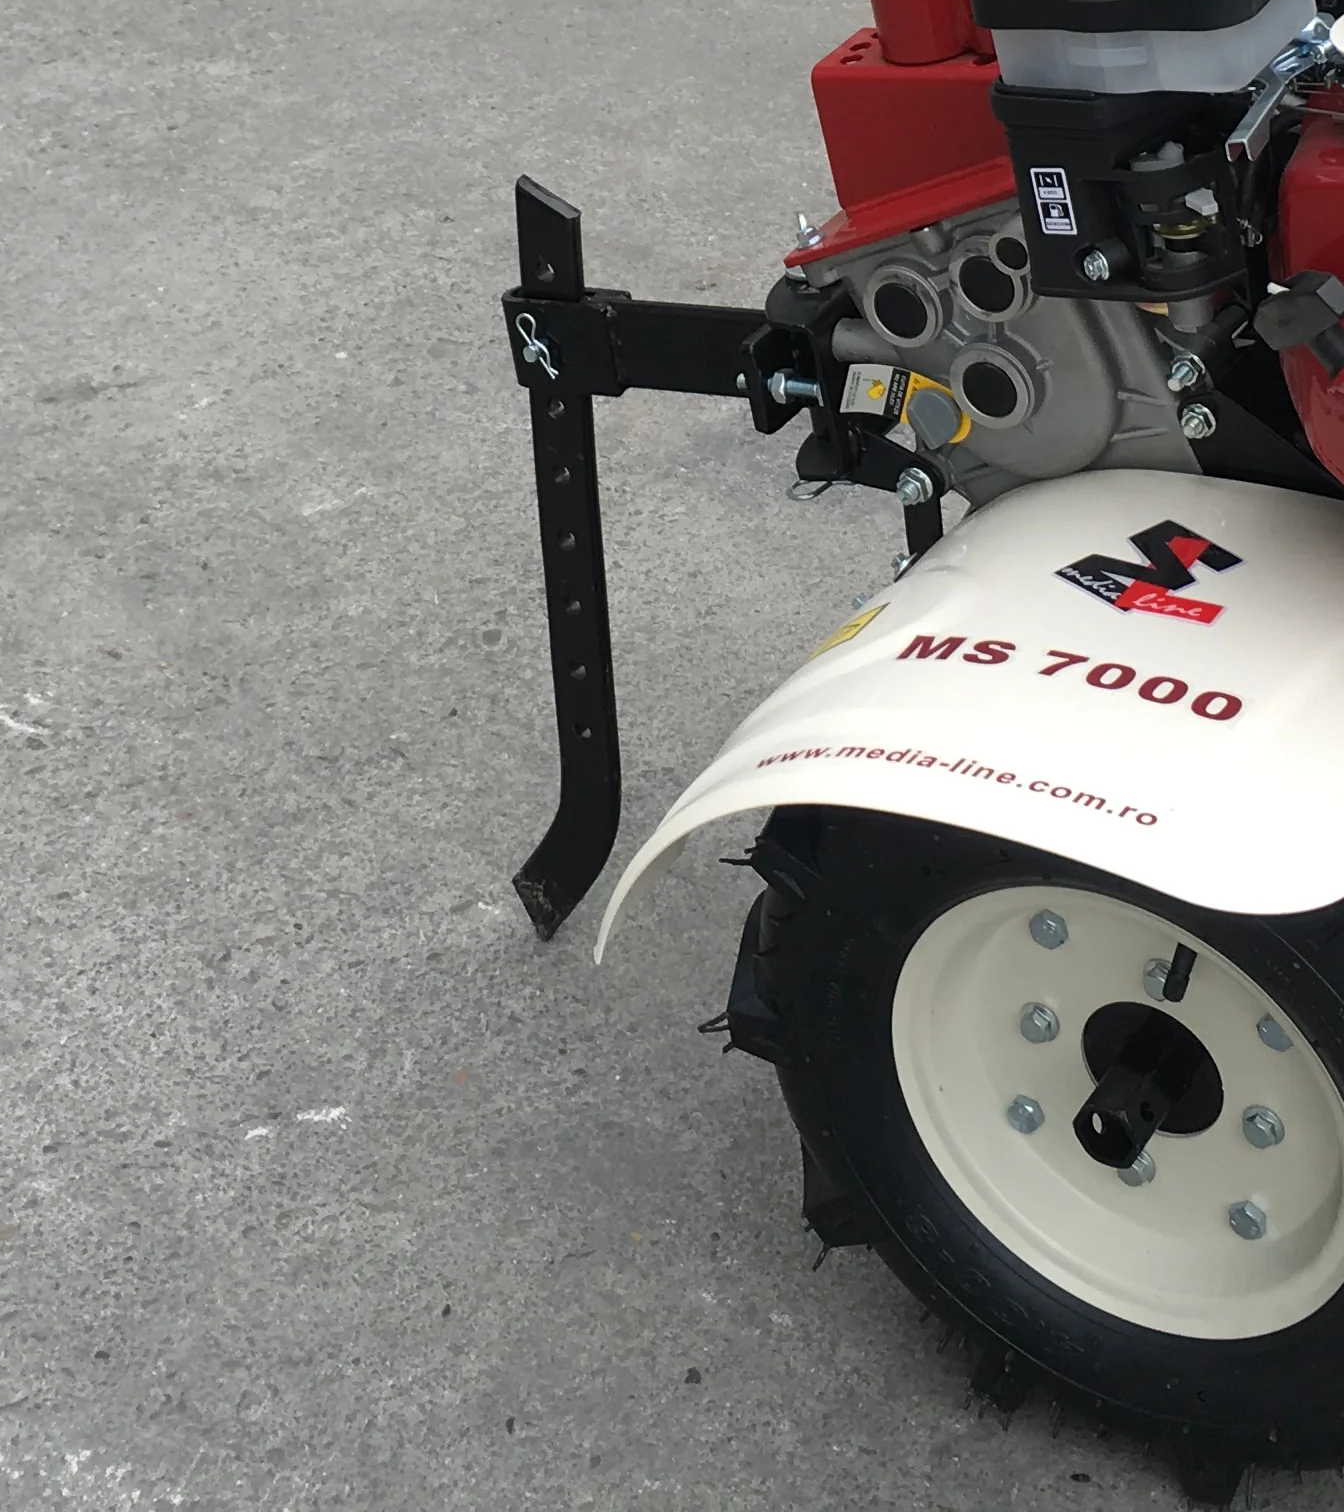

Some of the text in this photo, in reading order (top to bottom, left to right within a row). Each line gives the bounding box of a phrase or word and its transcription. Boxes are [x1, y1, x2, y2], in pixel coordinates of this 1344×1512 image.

[1060, 567, 1123, 601] media
[1132, 592, 1204, 618] line
[896, 634, 1244, 721] MS 7000
[756, 744, 1159, 828] www.media-line.com.ro
